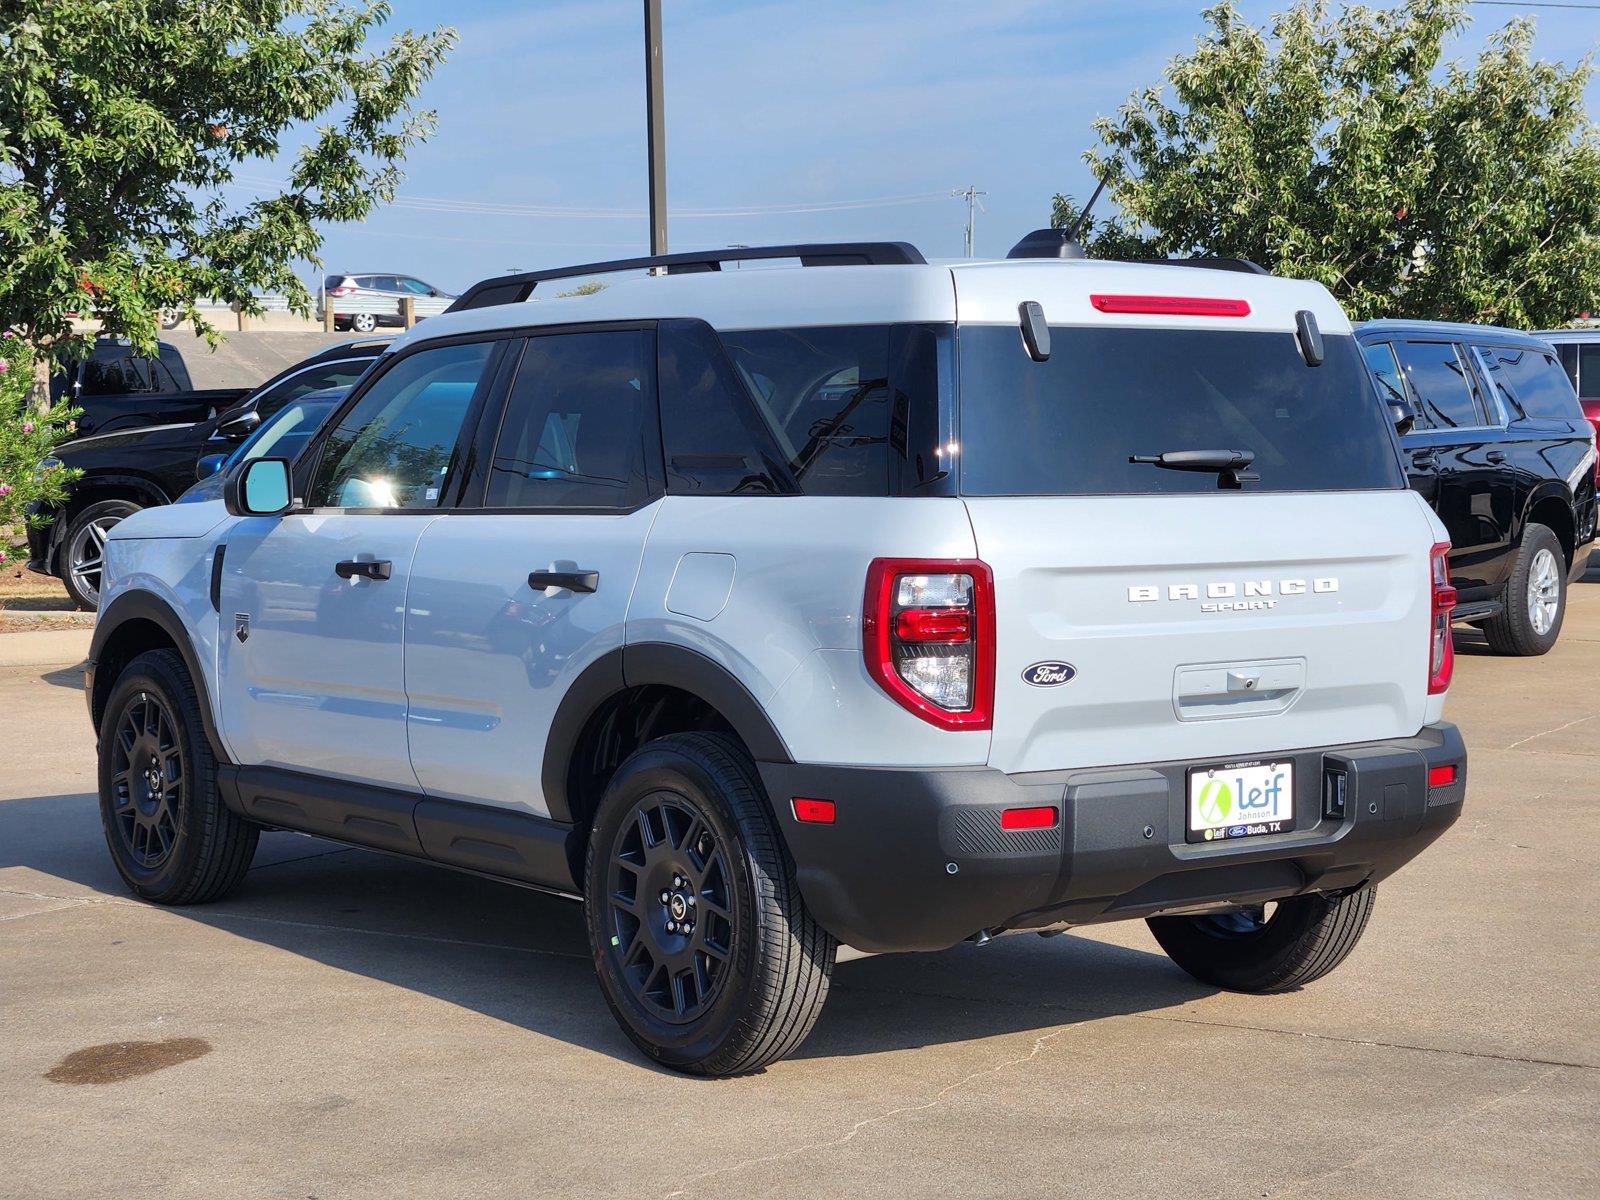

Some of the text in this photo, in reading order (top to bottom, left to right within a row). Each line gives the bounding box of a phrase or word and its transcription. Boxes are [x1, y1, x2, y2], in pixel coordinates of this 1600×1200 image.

[1128, 578, 1339, 603] BRONCO
[1201, 599, 1277, 612] SPORT
[1033, 665, 1068, 683] Ford
[1238, 810, 1271, 821] Johnson
[1247, 822, 1281, 835] Buda, TX
